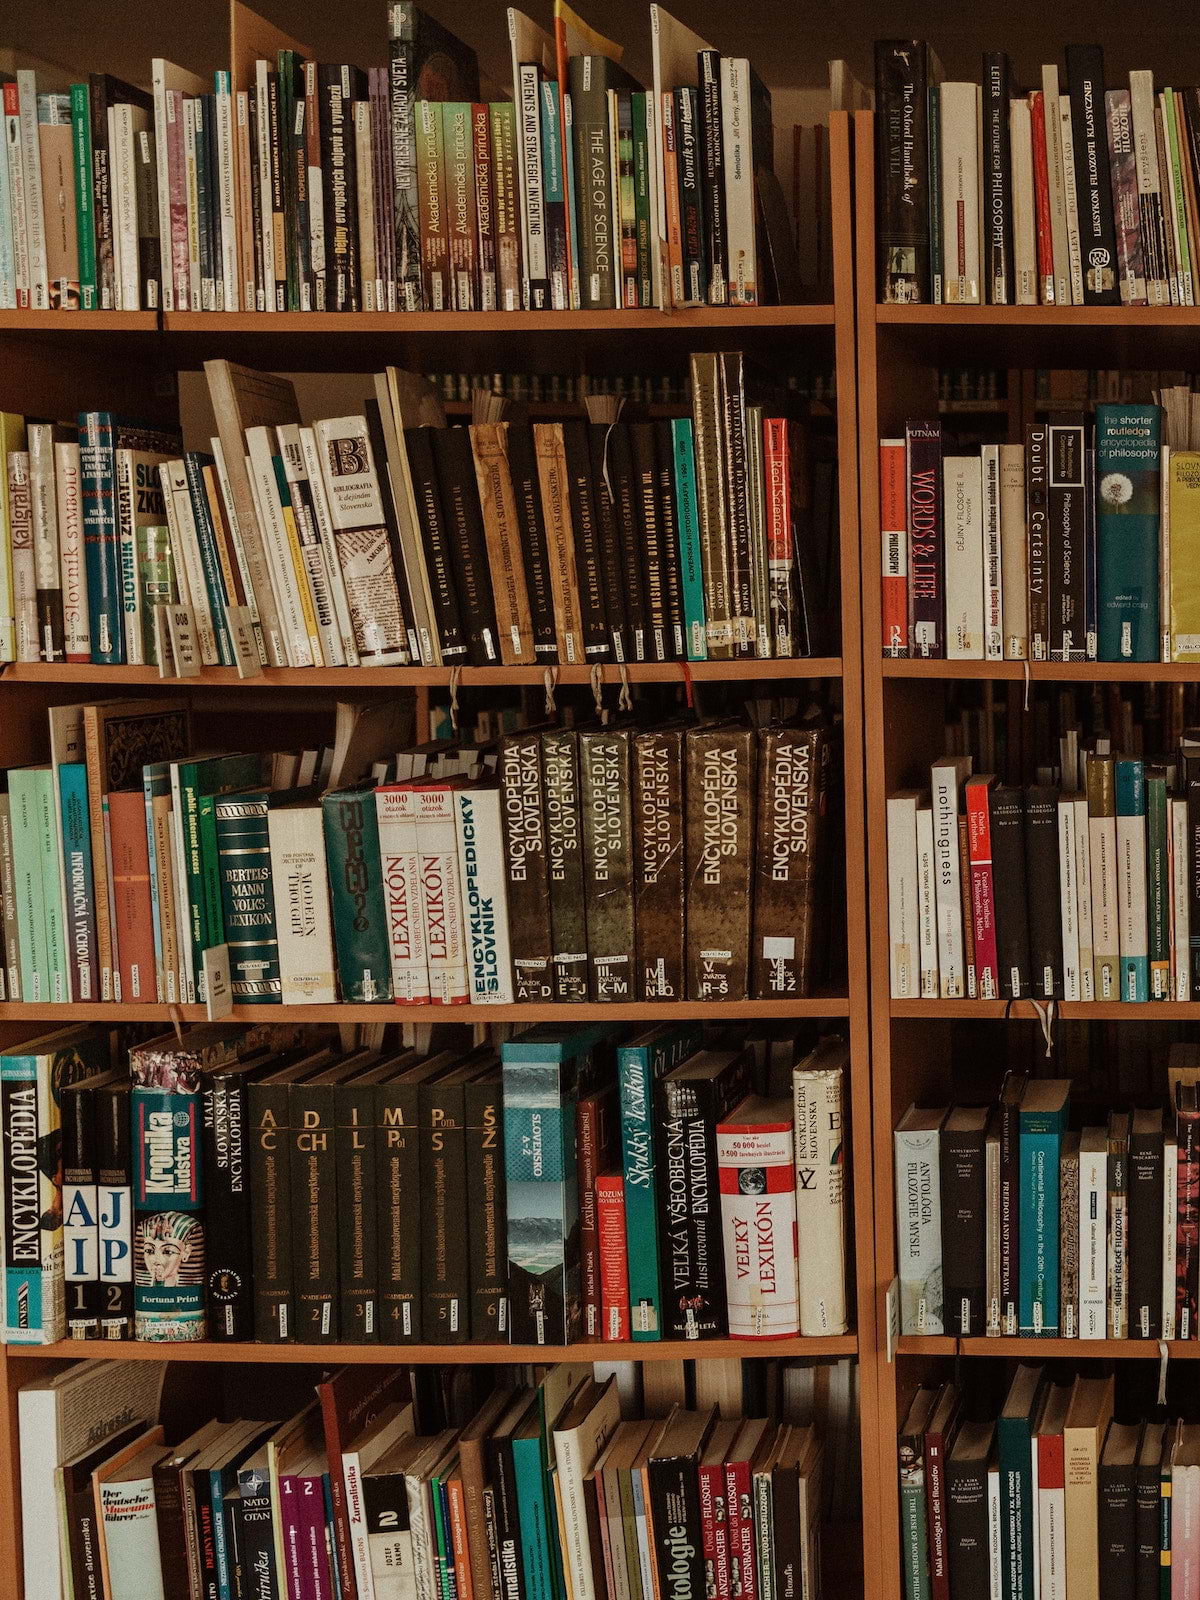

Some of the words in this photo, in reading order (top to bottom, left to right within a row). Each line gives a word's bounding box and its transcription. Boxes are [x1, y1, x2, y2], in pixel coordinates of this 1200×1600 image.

[523, 73, 534, 111] PATENTS
[904, 83, 913, 102] The
[990, 65, 1000, 98] LEITER
[456, 112, 466, 159] príručka
[477, 113, 487, 159] príručka
[525, 114, 536, 132] AND
[590, 129, 603, 153] THE
[904, 104, 913, 132] Oxford
[1112, 105, 1123, 154] LEXIKÓN
[1119, 102, 1130, 153] FILOZOFIE
[527, 136, 539, 186] STRATEGIC
[592, 154, 606, 185] AGE
[904, 135, 914, 190] Handbook
[456, 162, 467, 234] Akademická
[478, 161, 490, 237] Akademická
[529, 187, 540, 236] INVENTING
[593, 189, 607, 210] OF
[904, 191, 914, 205] of
[993, 173, 1003, 250] PHILOSOPHY
[333, 227, 348, 254] Dějiny
[594, 213, 609, 271] SCIENCE
[1100, 439, 1157, 448] encyclopedia
[1104, 416, 1117, 426] the
[1120, 416, 1153, 426] shorter
[1107, 427, 1151, 438] routledge
[771, 460, 782, 490] Real
[1030, 431, 1044, 484] Doubt
[1109, 448, 1158, 461] philosophy
[67, 465, 79, 539] SYMBOLŮ
[771, 492, 783, 536] Science
[913, 470, 937, 538] WORDS
[1062, 492, 1072, 535] Philosophy
[123, 540, 137, 613] SLOVNÍK
[888, 533, 900, 575] PHILOSOPHY
[1030, 511, 1045, 595] Certainty
[1062, 547, 1071, 586] Science
[63, 543, 80, 622] Slovník
[307, 547, 332, 627] CHRONOLÓGIA
[912, 563, 937, 600] LIFE
[383, 793, 408, 805] 3000
[419, 793, 445, 805] 3000
[504, 745, 527, 881] ENCYKLOPÉDIA
[521, 744, 542, 852] SLOVENSKA
[546, 745, 565, 880] ENCYKLOPÉDIA
[558, 744, 577, 849] SLOVENSKA
[592, 745, 608, 881] ENCYKLOPÉDIA
[605, 744, 622, 850] SLOVENSKA
[640, 747, 658, 883] ENCYKLOPÉDIA
[654, 748, 670, 853] SLOVENSKA
[703, 748, 721, 885] ENCYKLOPÉDIA
[721, 749, 737, 857] SLOVENSKA
[772, 744, 793, 881] ENCYKLOPÉDIA
[790, 744, 809, 853] SLOVENSKA
[938, 785, 951, 885] nothingness
[225, 869, 272, 883] BERTELS-
[231, 883, 265, 896] MANN
[460, 795, 484, 993] ENCYKLOPEDICKÝ
[232, 898, 269, 911] VOLKS-
[385, 856, 411, 960] LEXIKÓN
[422, 856, 447, 960] LEXIKÓN
[481, 897, 499, 992] SLOVNÍK
[202, 1089, 214, 1128] MALÁ
[624, 1062, 646, 1121] lexikón
[145, 1111, 173, 1194] Kronika
[213, 1088, 228, 1169] SLOVENSKÁ
[227, 1088, 243, 1192] ENCYKLOPÉDIA
[532, 1113, 543, 1177] SLOVENSKO
[12, 1087, 38, 1261] ENCYKLOPÉDIA
[626, 1127, 656, 1189] Školský
[663, 1119, 688, 1225] VŠEOBECNÁ
[685, 1119, 708, 1214] ENCYKLOPÉDIA
[63, 1189, 97, 1227] A
[102, 1191, 120, 1228] J
[908, 1161, 918, 1216] FILOZOFIE
[920, 1161, 931, 1226] ANTOLÓGIA
[102, 1239, 128, 1275] P
[695, 1219, 710, 1289] ilustrovaná
[754, 1201, 776, 1295] LEXIKÓN
[909, 1219, 920, 1257] MYSLE
[74, 1285, 87, 1310] 1
[107, 1286, 122, 1310] 2
[102, 1496, 149, 1505] deutsche
[243, 1497, 270, 1508] NATO
[351, 1466, 361, 1525] Žurnalistika
[700, 1473, 711, 1518] FILOSOFIE
[726, 1471, 738, 1516] FILOSOFIE
[931, 1465, 939, 1497] filozofov
[104, 1502, 155, 1513] Museums
[105, 1513, 136, 1522] führer
[243, 1511, 270, 1521] OTAN
[716, 1528, 728, 1595] ANZENBACHER
[741, 1526, 754, 1593] ANZENBACHER
[934, 1522, 943, 1555] antológia
[935, 1556, 944, 1577] Malá
